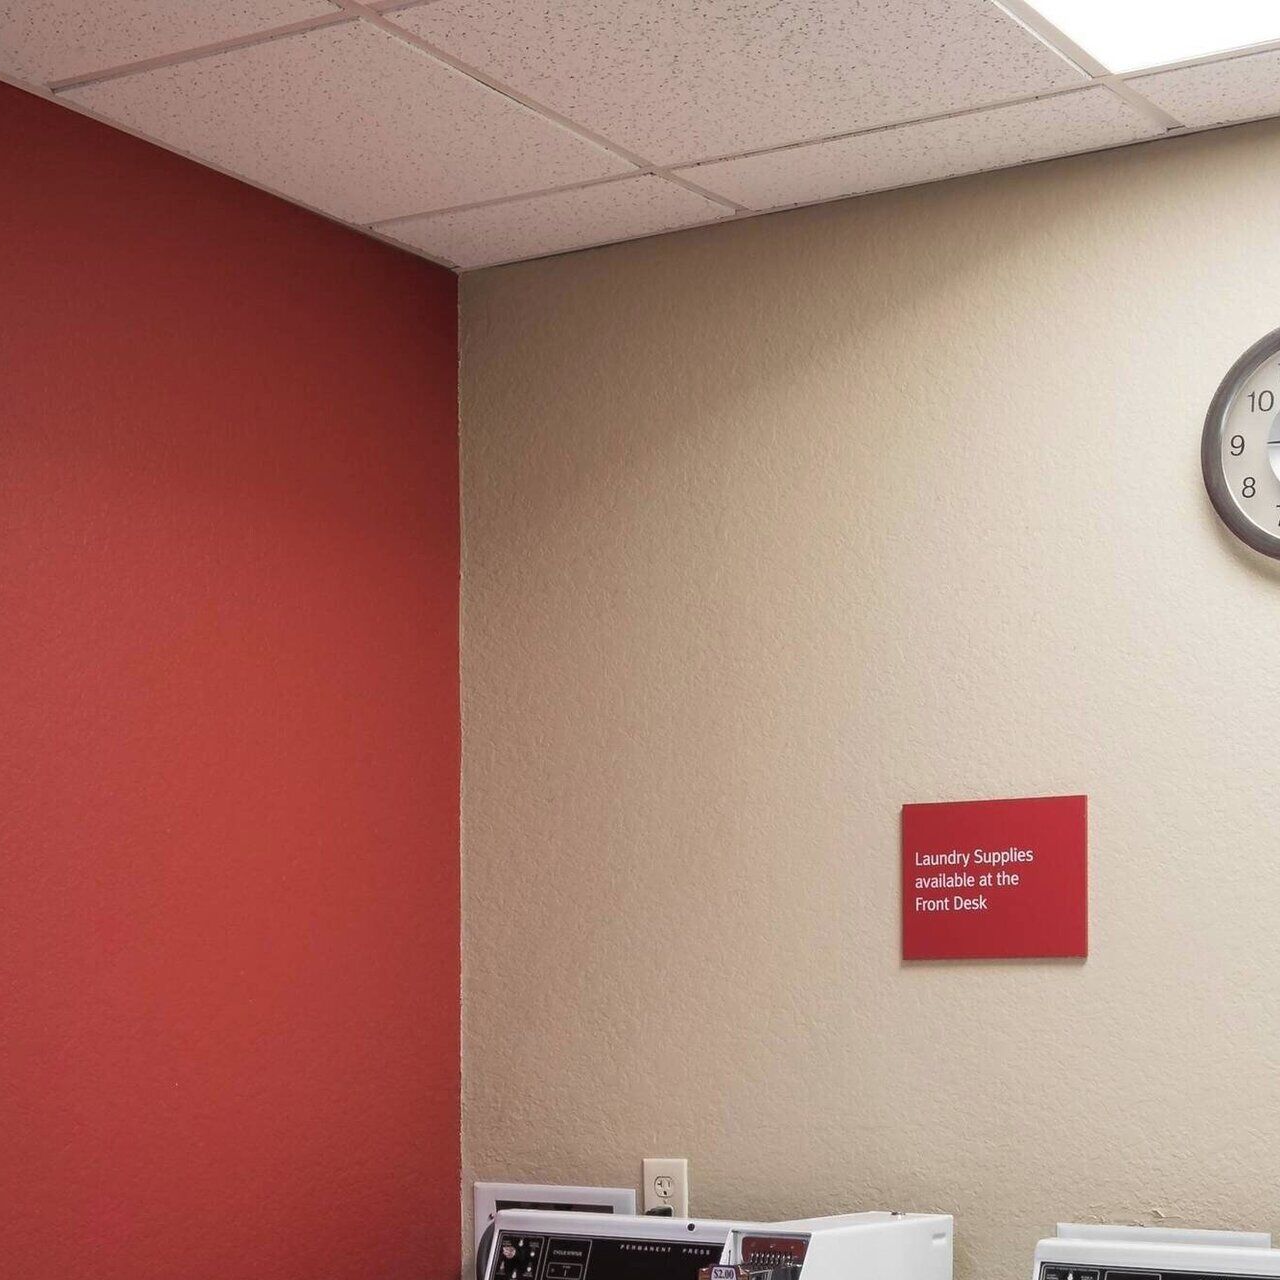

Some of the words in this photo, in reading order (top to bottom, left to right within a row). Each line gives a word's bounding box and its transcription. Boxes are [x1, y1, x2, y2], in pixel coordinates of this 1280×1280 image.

[1247, 390, 1275, 413] 10
[1230, 434, 1246, 457] 9
[1241, 476, 1257, 499] 8
[915, 849, 971, 868] Laundry
[973, 847, 1035, 867] Supplies
[915, 872, 976, 890] available
[978, 872, 993, 888] at
[996, 870, 1020, 887] the
[915, 896, 950, 913] Front
[953, 894, 988, 912] Desk
[620, 1243, 672, 1254] PERMANENT
[682, 1247, 711, 1256] PRESS
[713, 1268, 735, 1280] $2.00
